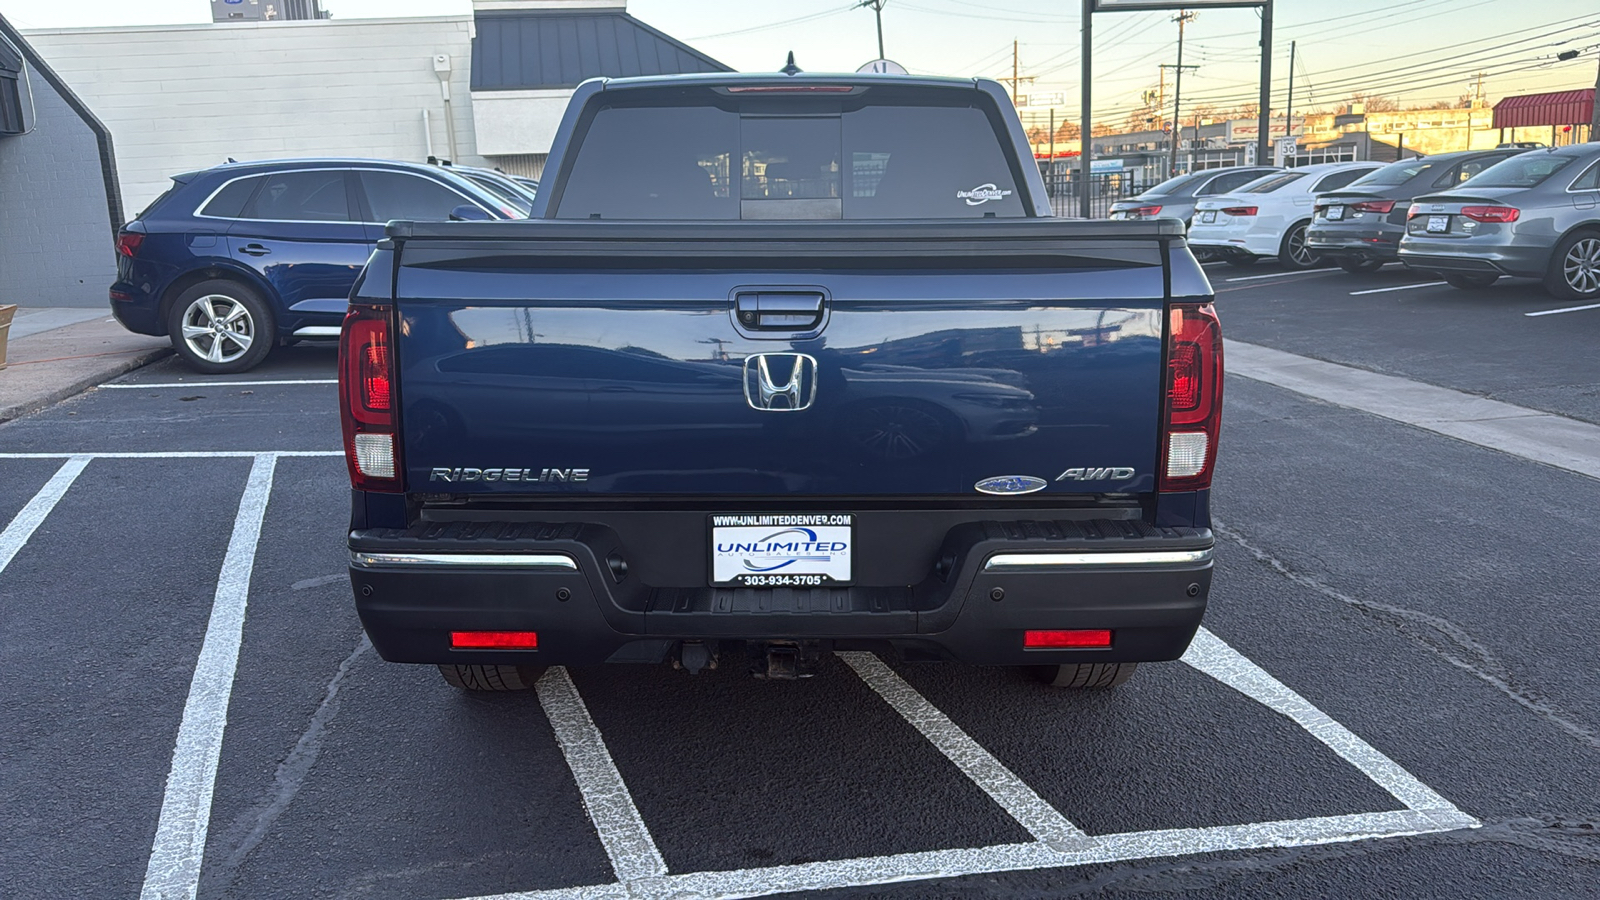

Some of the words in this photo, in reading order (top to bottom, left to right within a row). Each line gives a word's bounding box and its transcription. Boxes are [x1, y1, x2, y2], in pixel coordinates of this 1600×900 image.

[1282, 145, 1295, 154] 30
[429, 467, 590, 482] RIDGELINE
[1055, 467, 1135, 481] AWD
[717, 542, 848, 552] UNLIMITED
[744, 575, 821, 586] 303-934-3705
